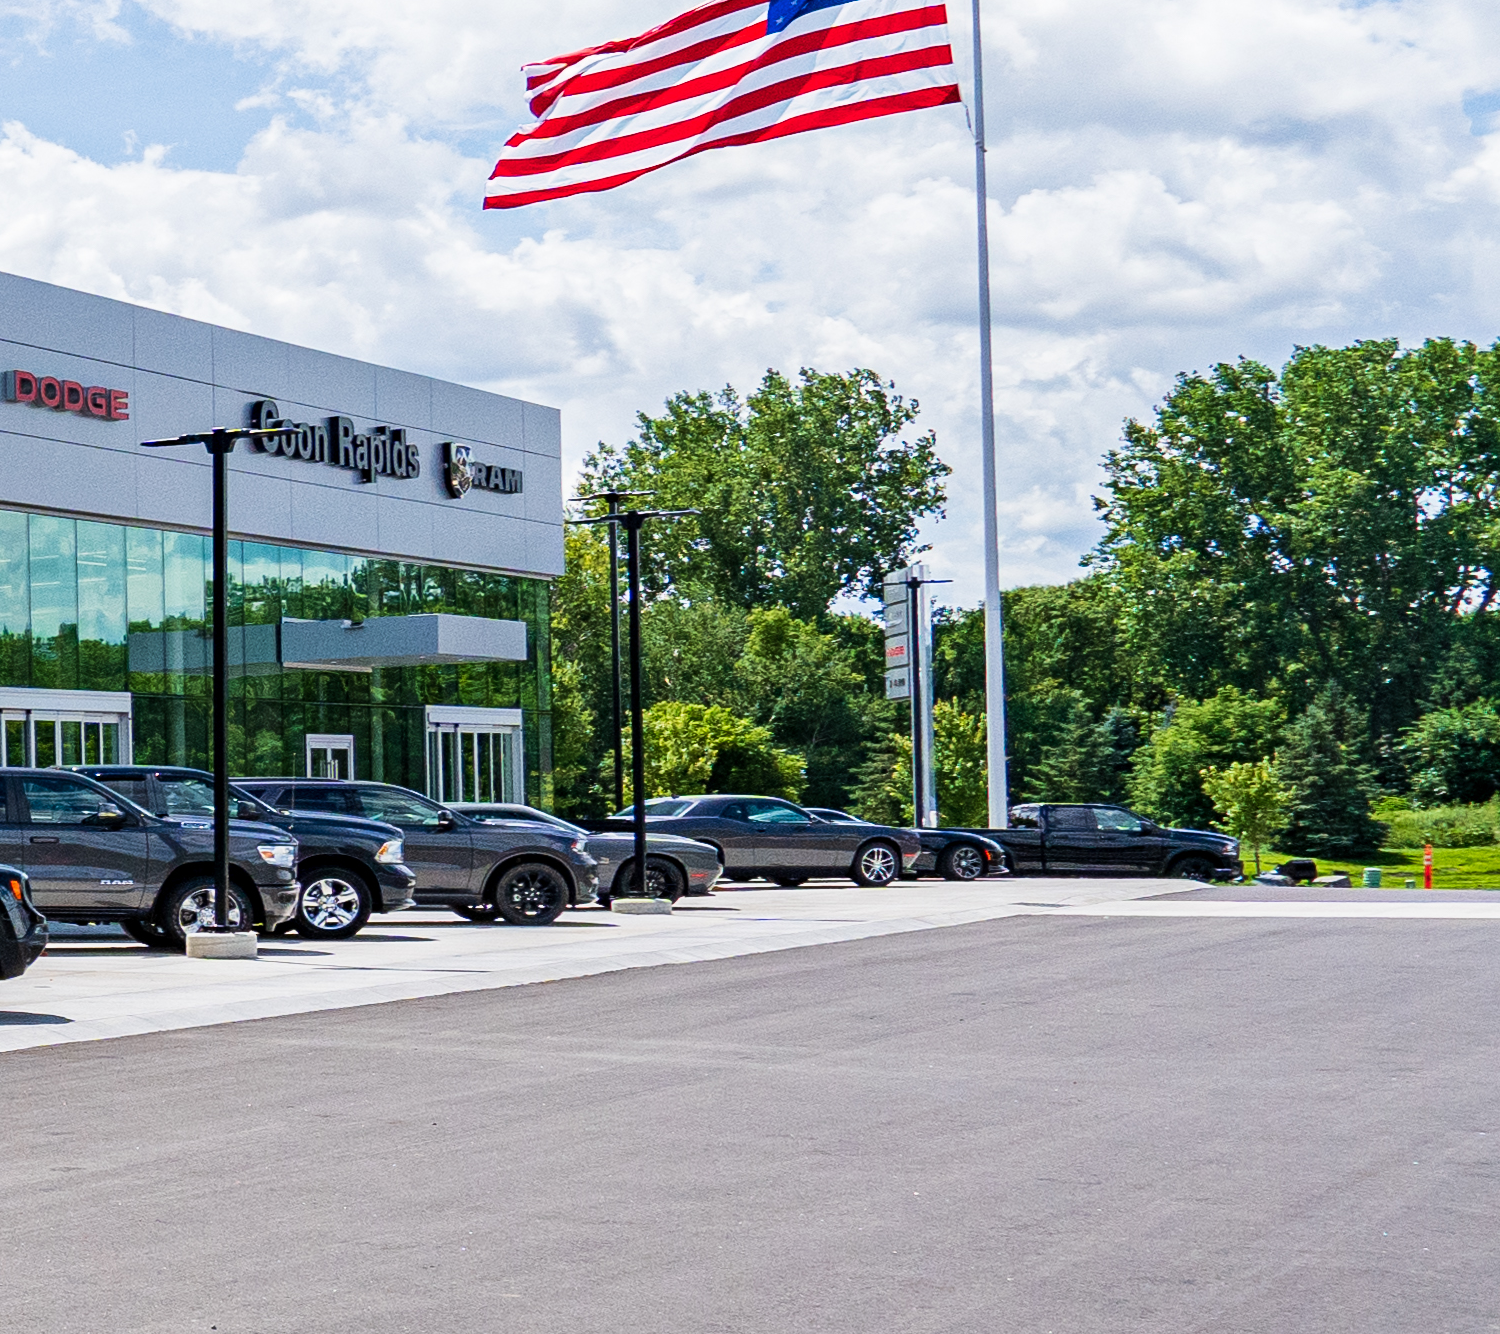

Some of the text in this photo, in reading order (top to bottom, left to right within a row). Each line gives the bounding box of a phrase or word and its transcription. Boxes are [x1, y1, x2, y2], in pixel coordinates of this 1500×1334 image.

[5, 369, 130, 420] DODGE
[251, 399, 420, 483] Coon Rapids
[472, 461, 524, 495] RAM
